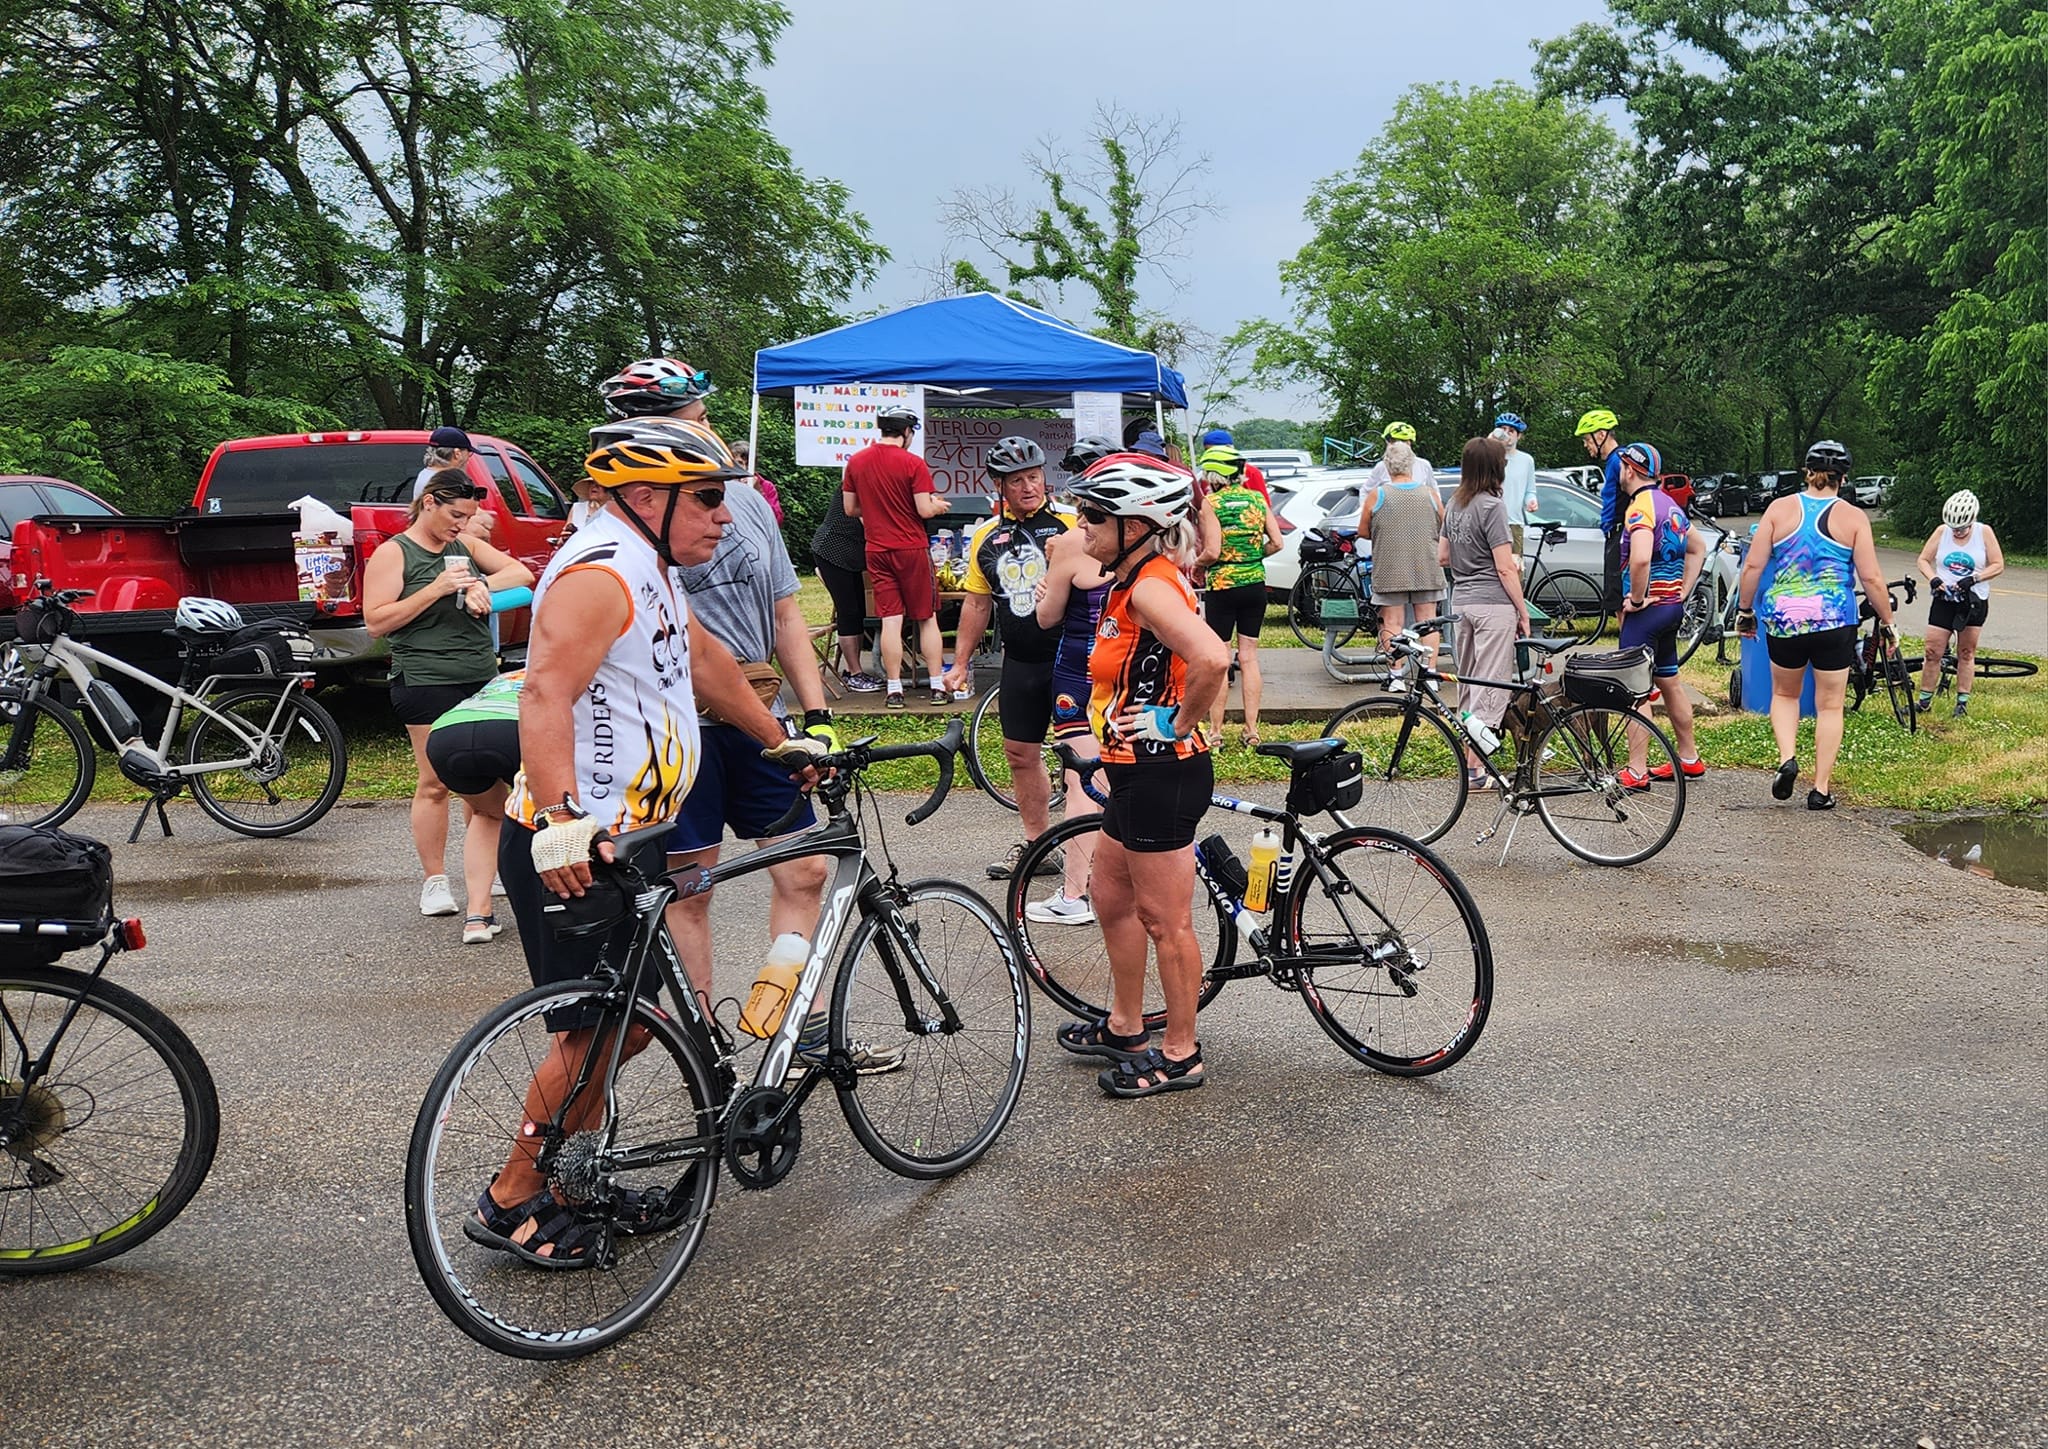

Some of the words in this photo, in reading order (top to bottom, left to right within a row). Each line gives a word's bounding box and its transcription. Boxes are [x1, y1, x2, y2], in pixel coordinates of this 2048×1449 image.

[833, 386, 879, 397] MARK'S
[882, 388, 908, 398] UMC
[795, 401, 821, 411] FREE
[825, 402, 850, 412] WILL
[799, 418, 819, 428] ALL
[924, 420, 1002, 436] TERLOO
[817, 436, 856, 446] CEDAR
[930, 469, 989, 494] ORK
[305, 554, 331, 571] Little
[314, 562, 341, 577] Bites
[588, 682, 613, 766] RIDERS
[591, 772, 613, 800] CC
[1356, 839, 1417, 860] VELOMAX
[890, 908, 941, 995] ORBEA
[658, 930, 700, 1024] ORBEA
[764, 883, 854, 1089] ORBEA
